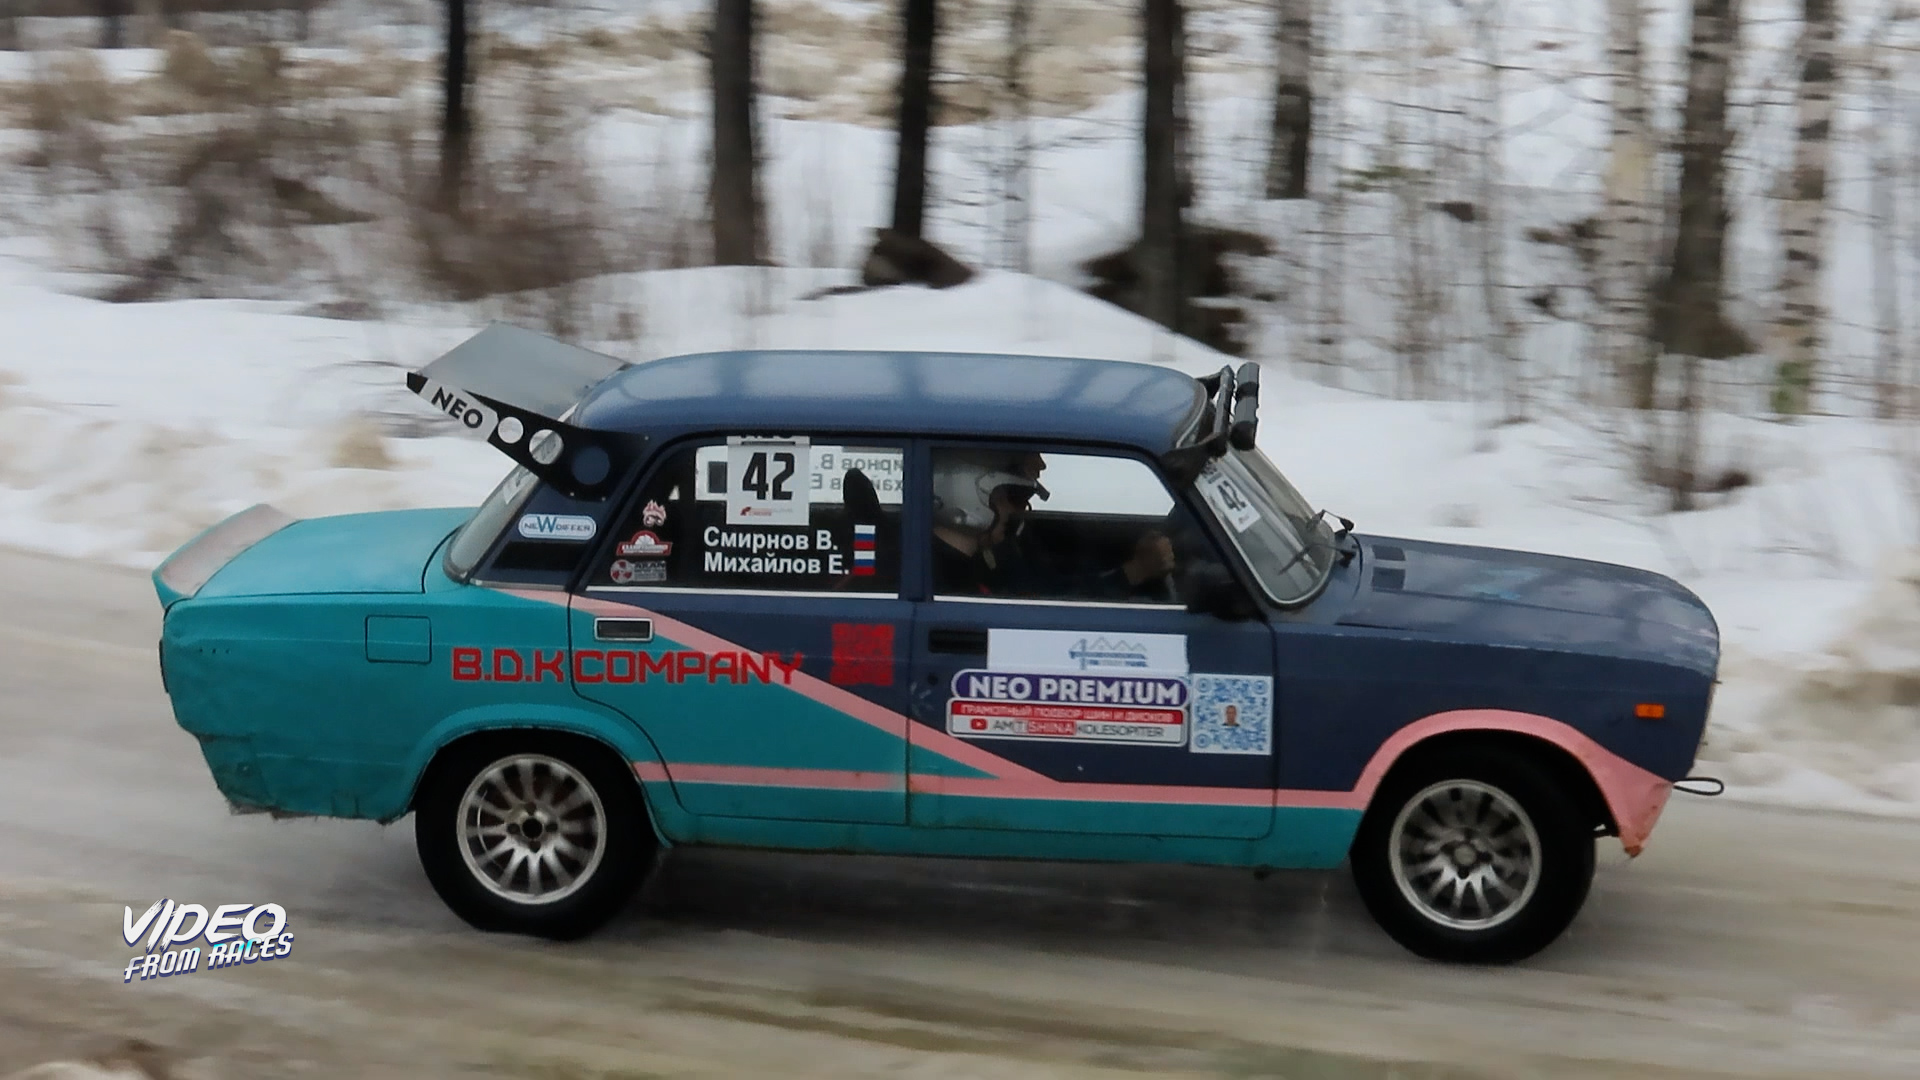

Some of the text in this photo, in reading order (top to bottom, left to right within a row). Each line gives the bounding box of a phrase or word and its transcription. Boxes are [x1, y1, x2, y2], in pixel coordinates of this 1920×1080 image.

[431, 387, 483, 428] NEO
[742, 452, 795, 500] 42
[1217, 480, 1247, 511] 42
[704, 526, 838, 553] Смирнов В.
[704, 552, 850, 575] Михайлов Е.
[573, 651, 803, 684] COMPANY
[968, 675, 1180, 705] NEO PREMIUM
[961, 703, 1174, 722] ГРАМОТНЫЙ ПОДБОР ШИН И ДИСКОВ
